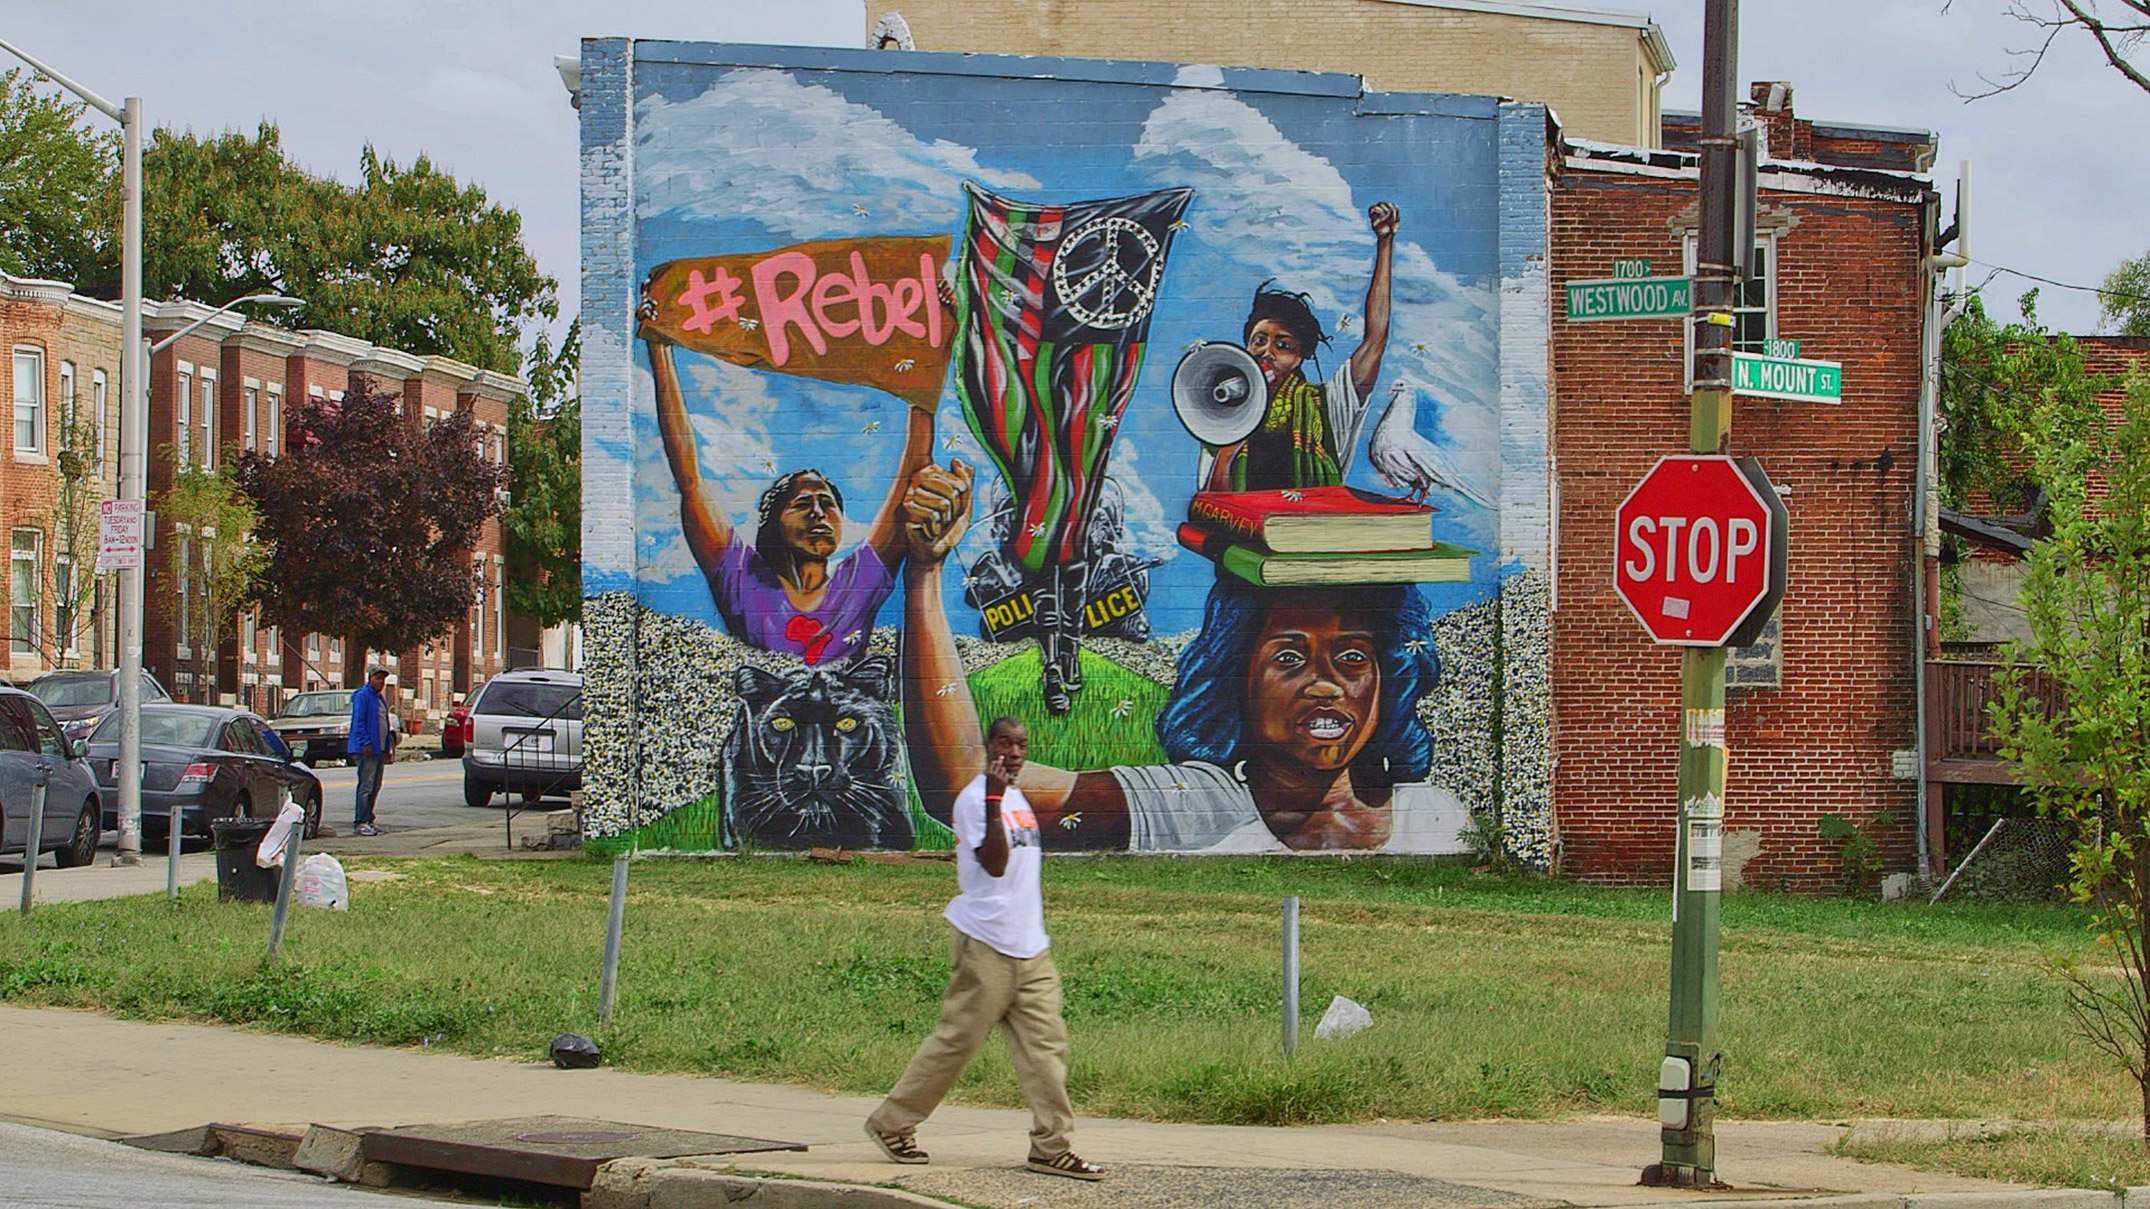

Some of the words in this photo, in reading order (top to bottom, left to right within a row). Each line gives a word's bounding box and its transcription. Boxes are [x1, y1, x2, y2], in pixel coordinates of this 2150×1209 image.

[1615, 260, 1644, 278] 1700
[678, 251, 942, 367] #Rebel
[1570, 284, 1668, 316] WESTWOOD
[1671, 289, 1688, 308] AV.
[1768, 340, 1796, 359] 1800
[1738, 361, 1754, 389] N.
[1760, 362, 1817, 395] MOUNT
[1820, 373, 1834, 391] ST.
[114, 503, 139, 513] PARKING
[111, 525, 129, 534] FRIDAY
[1625, 515, 1758, 583] STOP
[985, 593, 1034, 631] POLI
[1086, 586, 1140, 629] LICE
